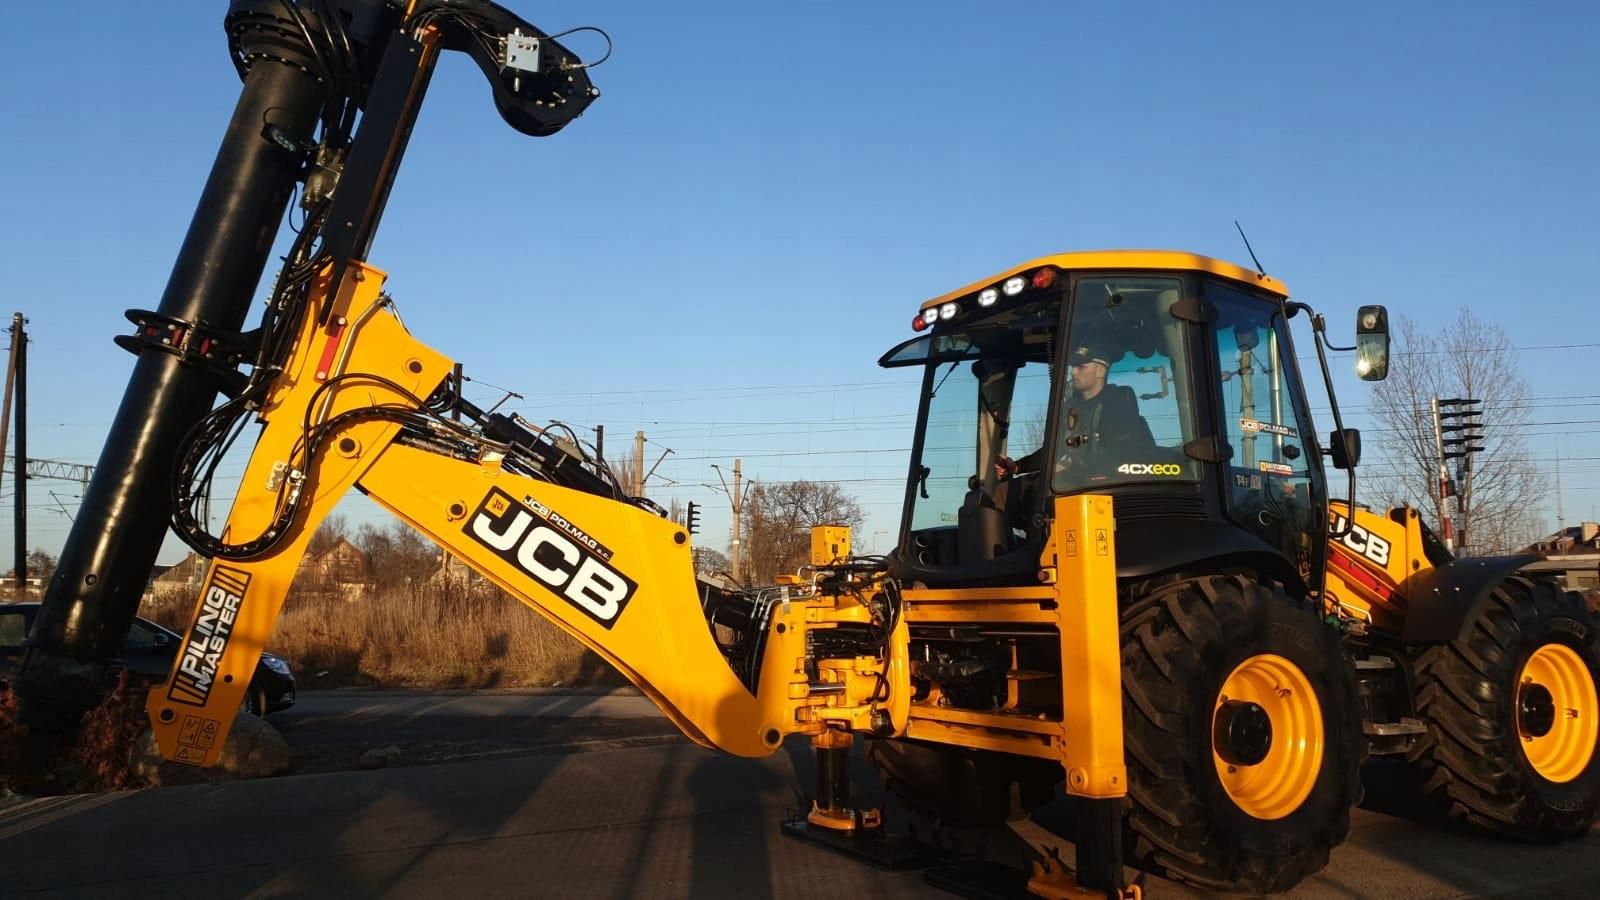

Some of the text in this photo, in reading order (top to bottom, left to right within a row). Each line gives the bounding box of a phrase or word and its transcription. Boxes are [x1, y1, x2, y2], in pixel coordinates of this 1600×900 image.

[1241, 419, 1258, 430] JCB
[1117, 463, 1181, 475] 4CXeco
[523, 496, 549, 518] JCB
[549, 512, 597, 549] POLMAG
[472, 509, 629, 621] JCB
[180, 585, 226, 676] PILING
[194, 592, 241, 693] MASTER
